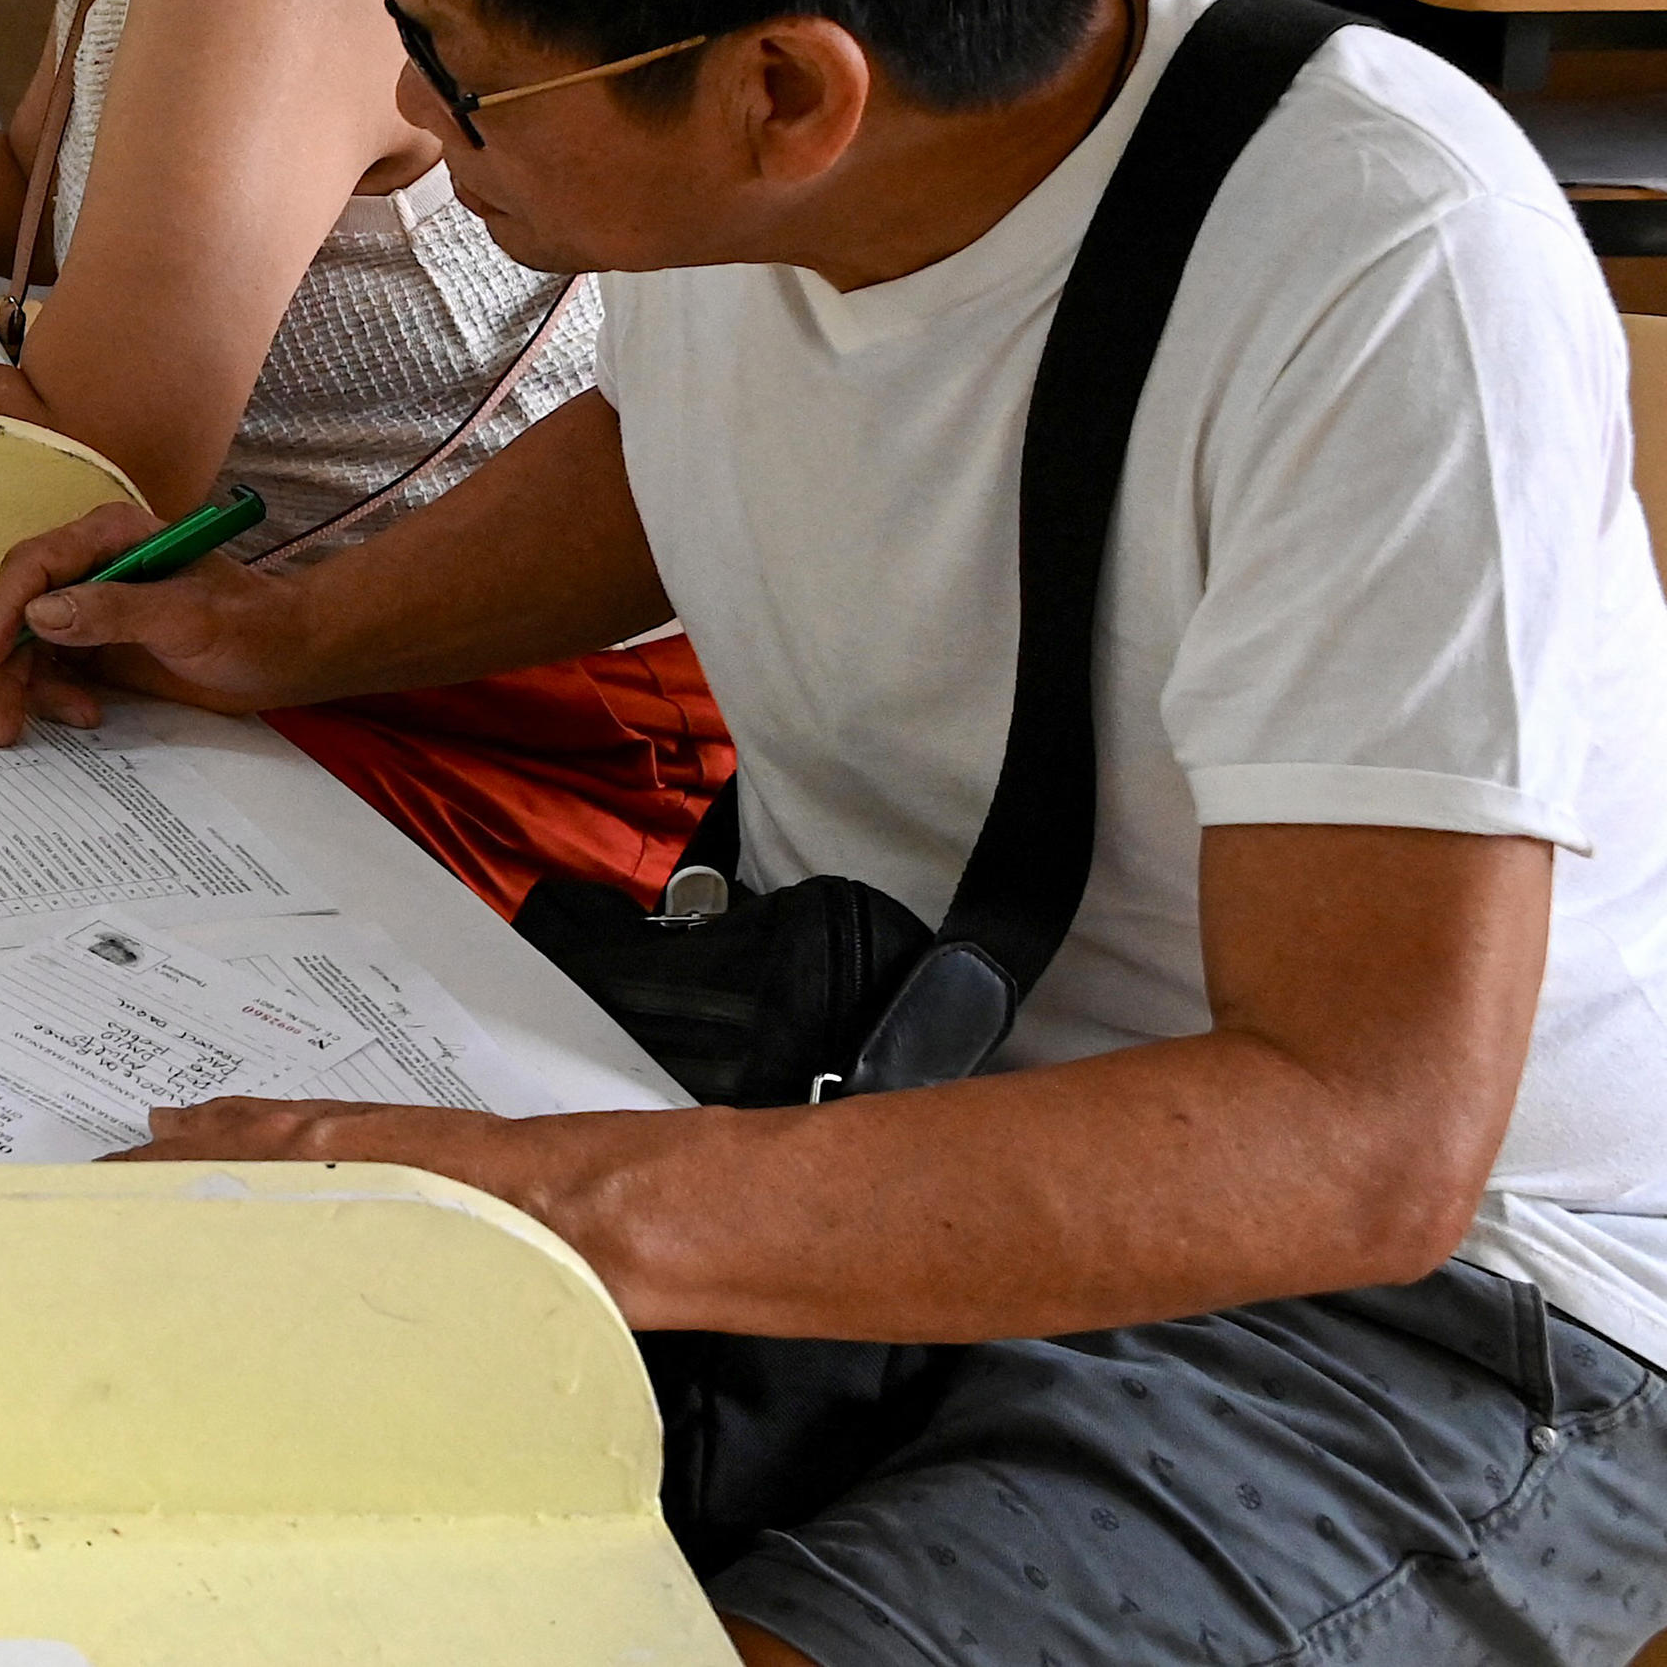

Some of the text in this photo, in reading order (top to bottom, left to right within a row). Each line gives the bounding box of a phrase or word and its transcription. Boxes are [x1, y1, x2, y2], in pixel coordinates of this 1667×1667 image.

[13, 1031, 65, 1061] BARANGAY
[0, 1105, 23, 1119] CITY
[65, 1093, 119, 1123] BARANGAY
